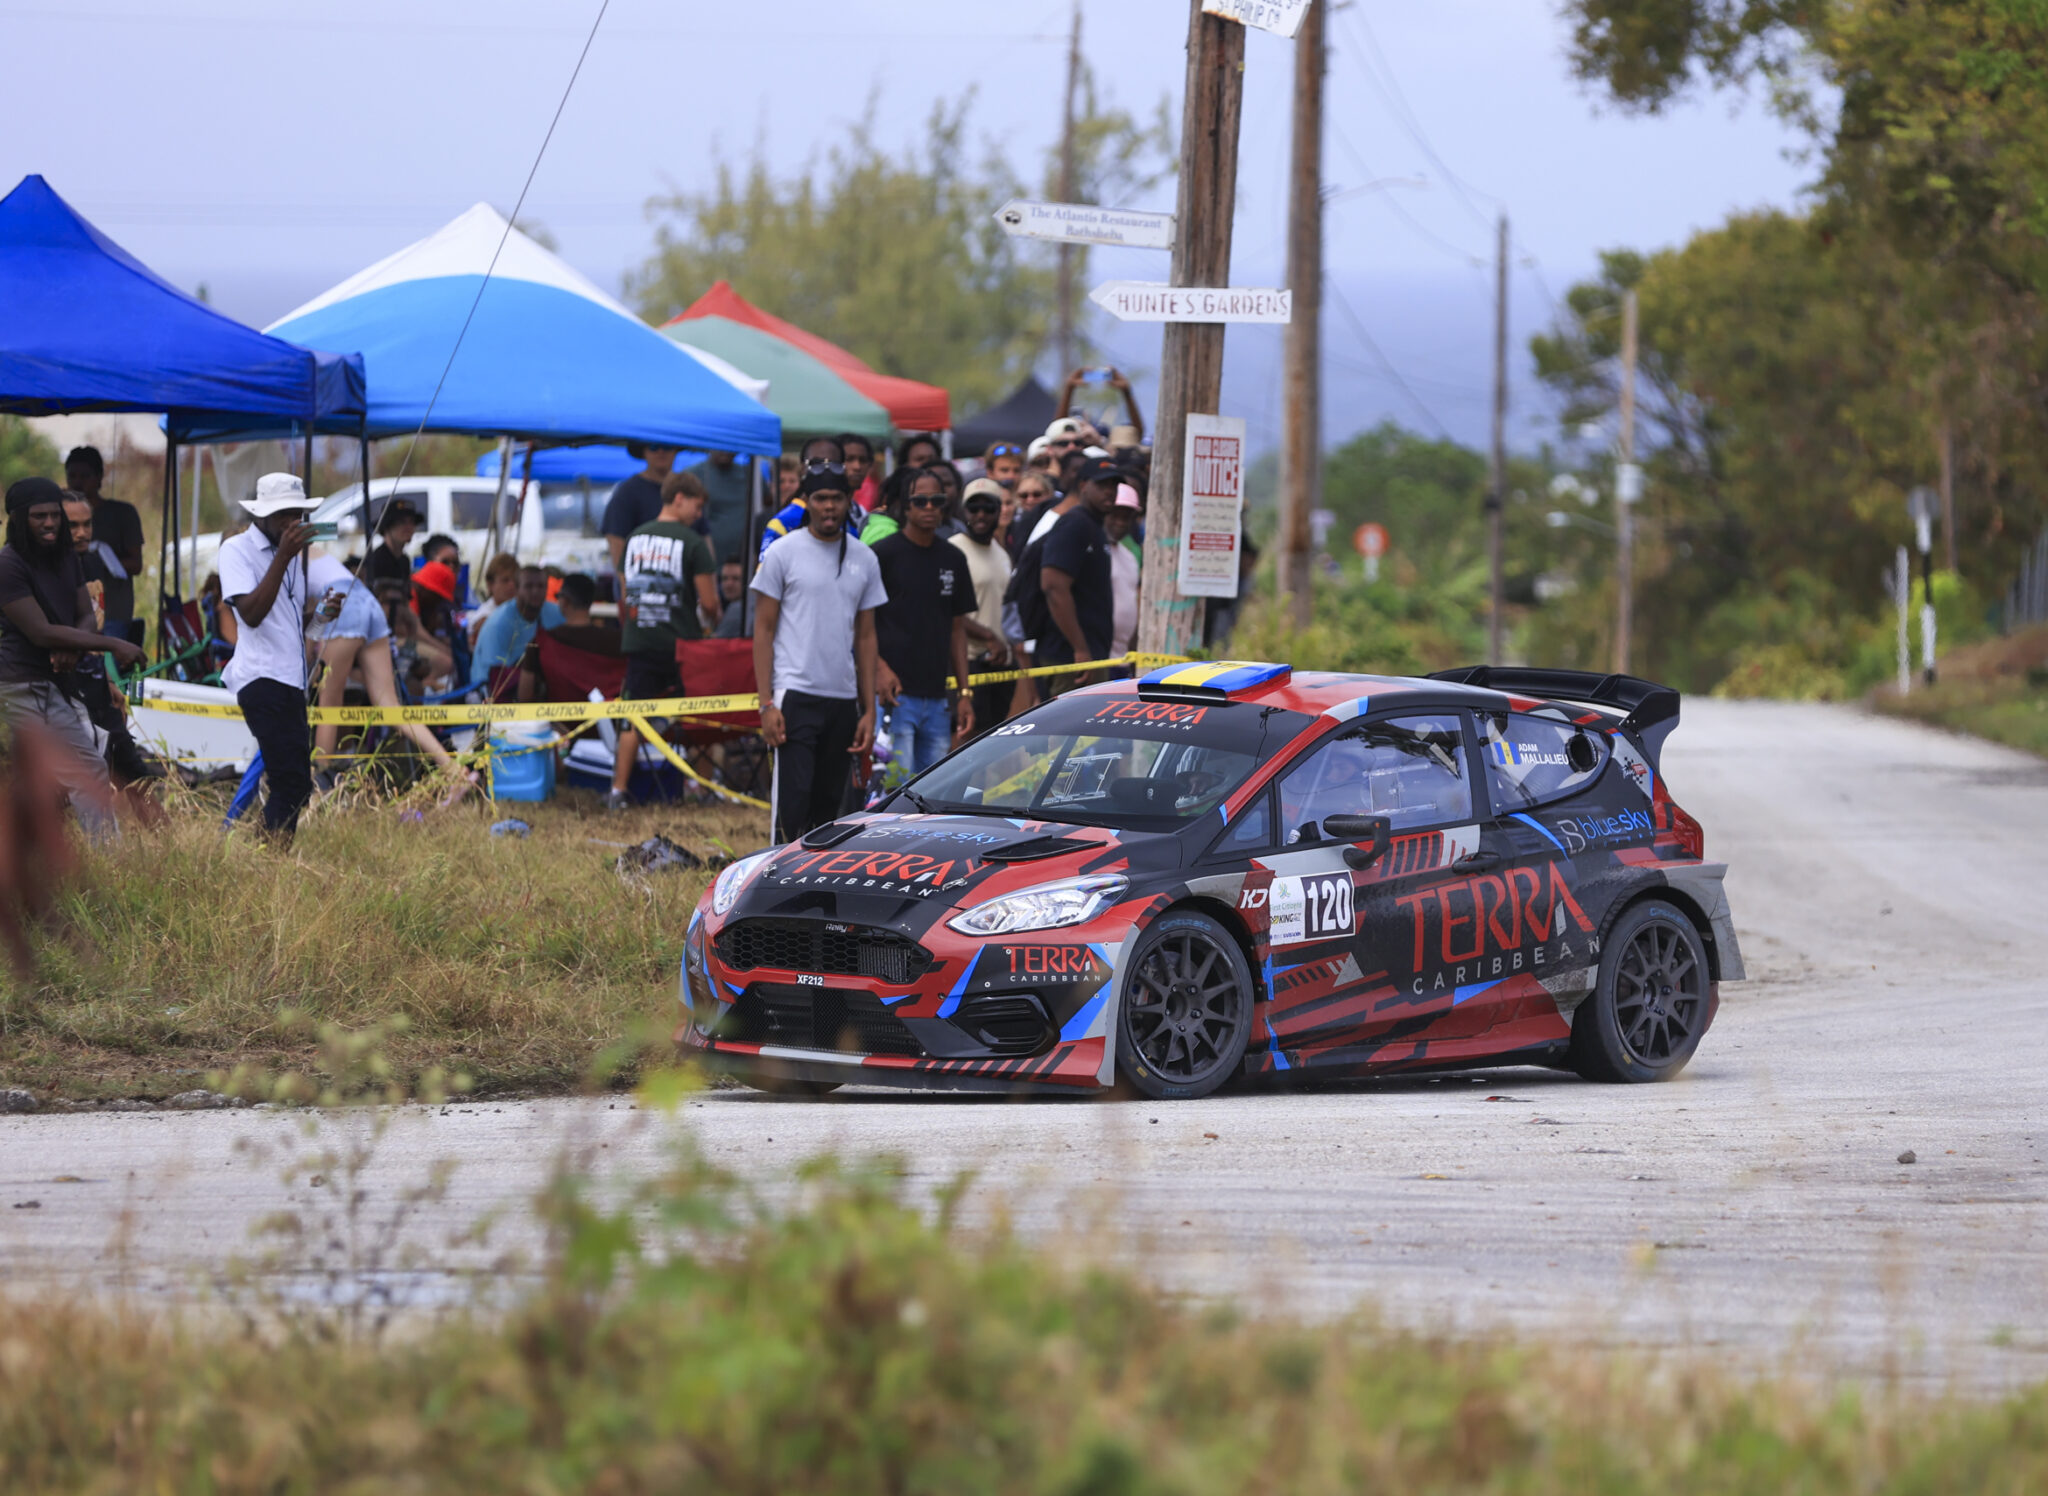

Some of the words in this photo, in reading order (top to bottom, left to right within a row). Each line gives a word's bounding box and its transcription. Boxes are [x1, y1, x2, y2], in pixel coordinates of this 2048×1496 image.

[1031, 206, 1052, 219] The
[1053, 208, 1098, 223] Atlantis
[1100, 212, 1163, 228] Restaurant
[1203, 294, 1289, 316] GARDENS
[340, 710, 384, 722] CAUTION
[402, 709, 448, 722] CAUTION
[467, 706, 517, 720] CAUTION
[536, 703, 587, 718] CAUTION
[606, 702, 658, 715] CAUTION
[678, 698, 730, 711] CAUTION
[1095, 700, 1209, 725] TERRA
[990, 723, 1036, 737] 120
[1085, 718, 1193, 730] CARIBBEAN
[1518, 743, 1539, 752] ADAM
[1520, 753, 1569, 765] MALLALIEU
[793, 850, 956, 886] TERRA
[779, 876, 935, 897] CARIBBEAN
[1307, 878, 1351, 932] 120
[1395, 860, 1596, 973] TERRA
[1002, 945, 1100, 973] TERRA
[1412, 936, 1601, 995] CARIBBEAN
[797, 974, 824, 986] XF212
